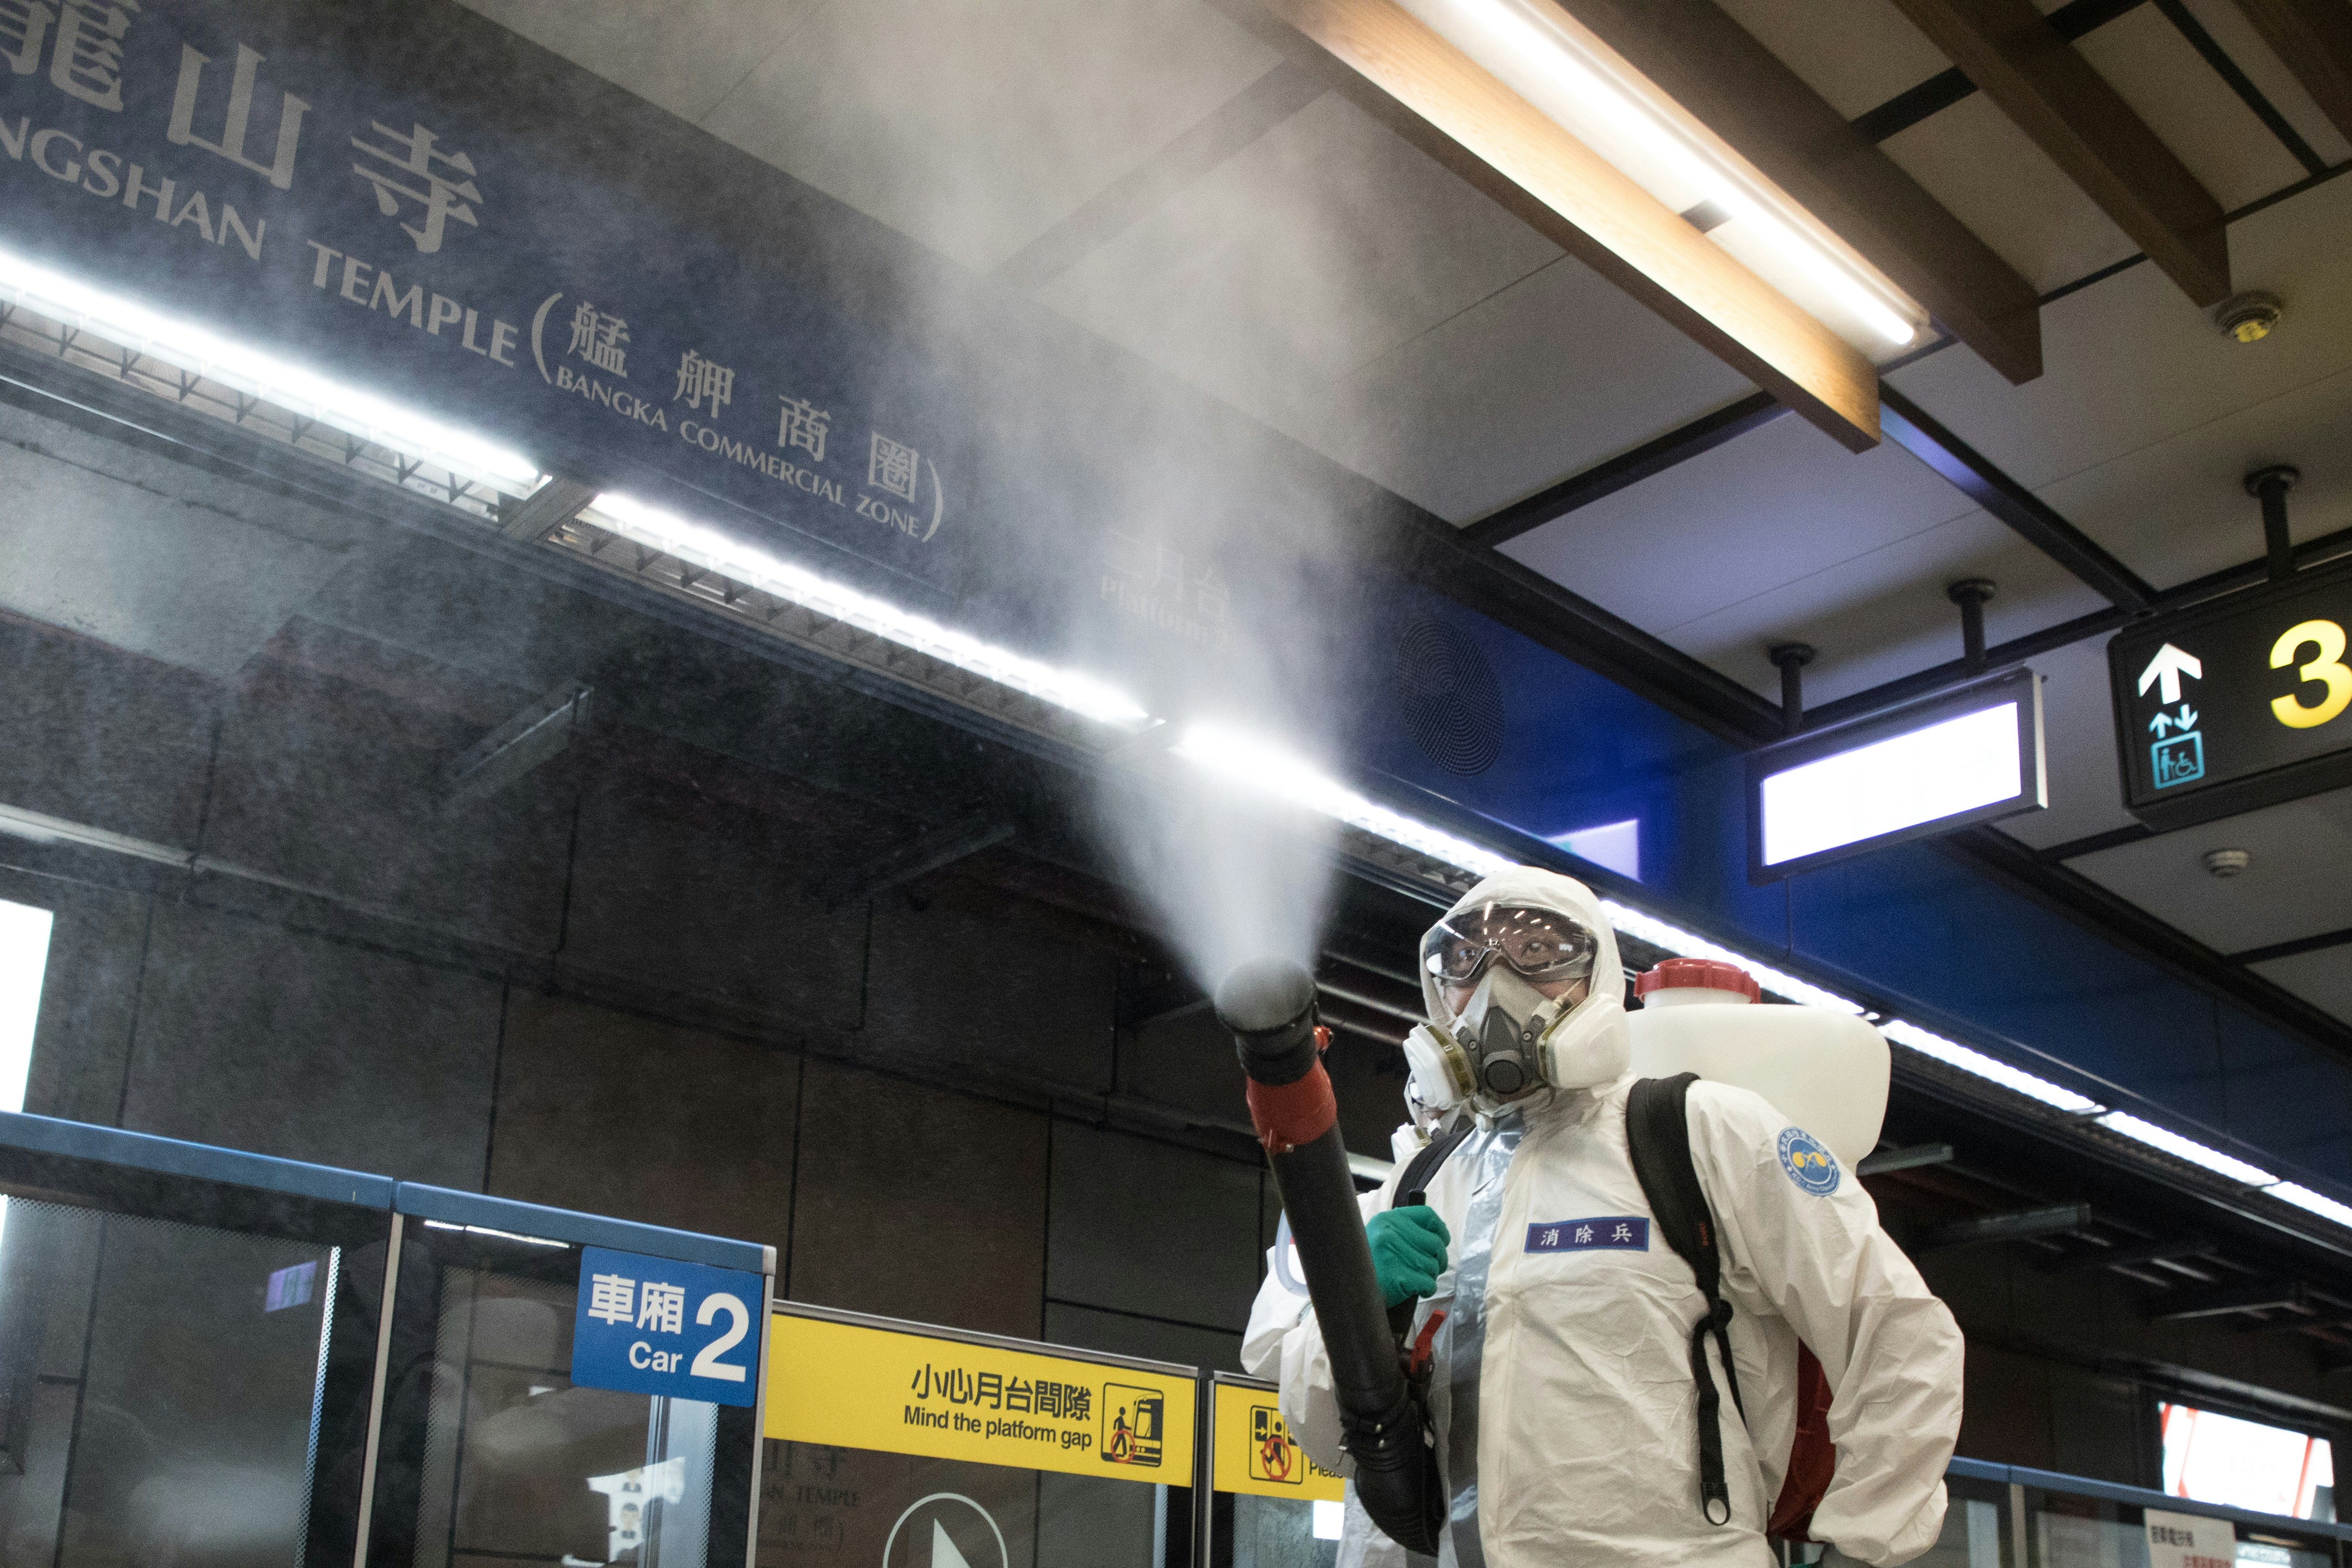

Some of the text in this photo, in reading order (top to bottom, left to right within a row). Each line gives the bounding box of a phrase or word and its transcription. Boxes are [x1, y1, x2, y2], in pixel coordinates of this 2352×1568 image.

[307, 240, 518, 368] TEMPLE
[556, 366, 920, 538] BANGKA COMMERCIAL ZONE
[2270, 619, 2352, 729] 3
[1541, 1223, 1632, 1246] 消除兵
[588, 1274, 685, 1335] 車廂
[629, 1292, 749, 1383] Car 2
[904, 1405, 1092, 1451] Mind the platform gap
[910, 1364, 1092, 1421] 小心月台間隙
